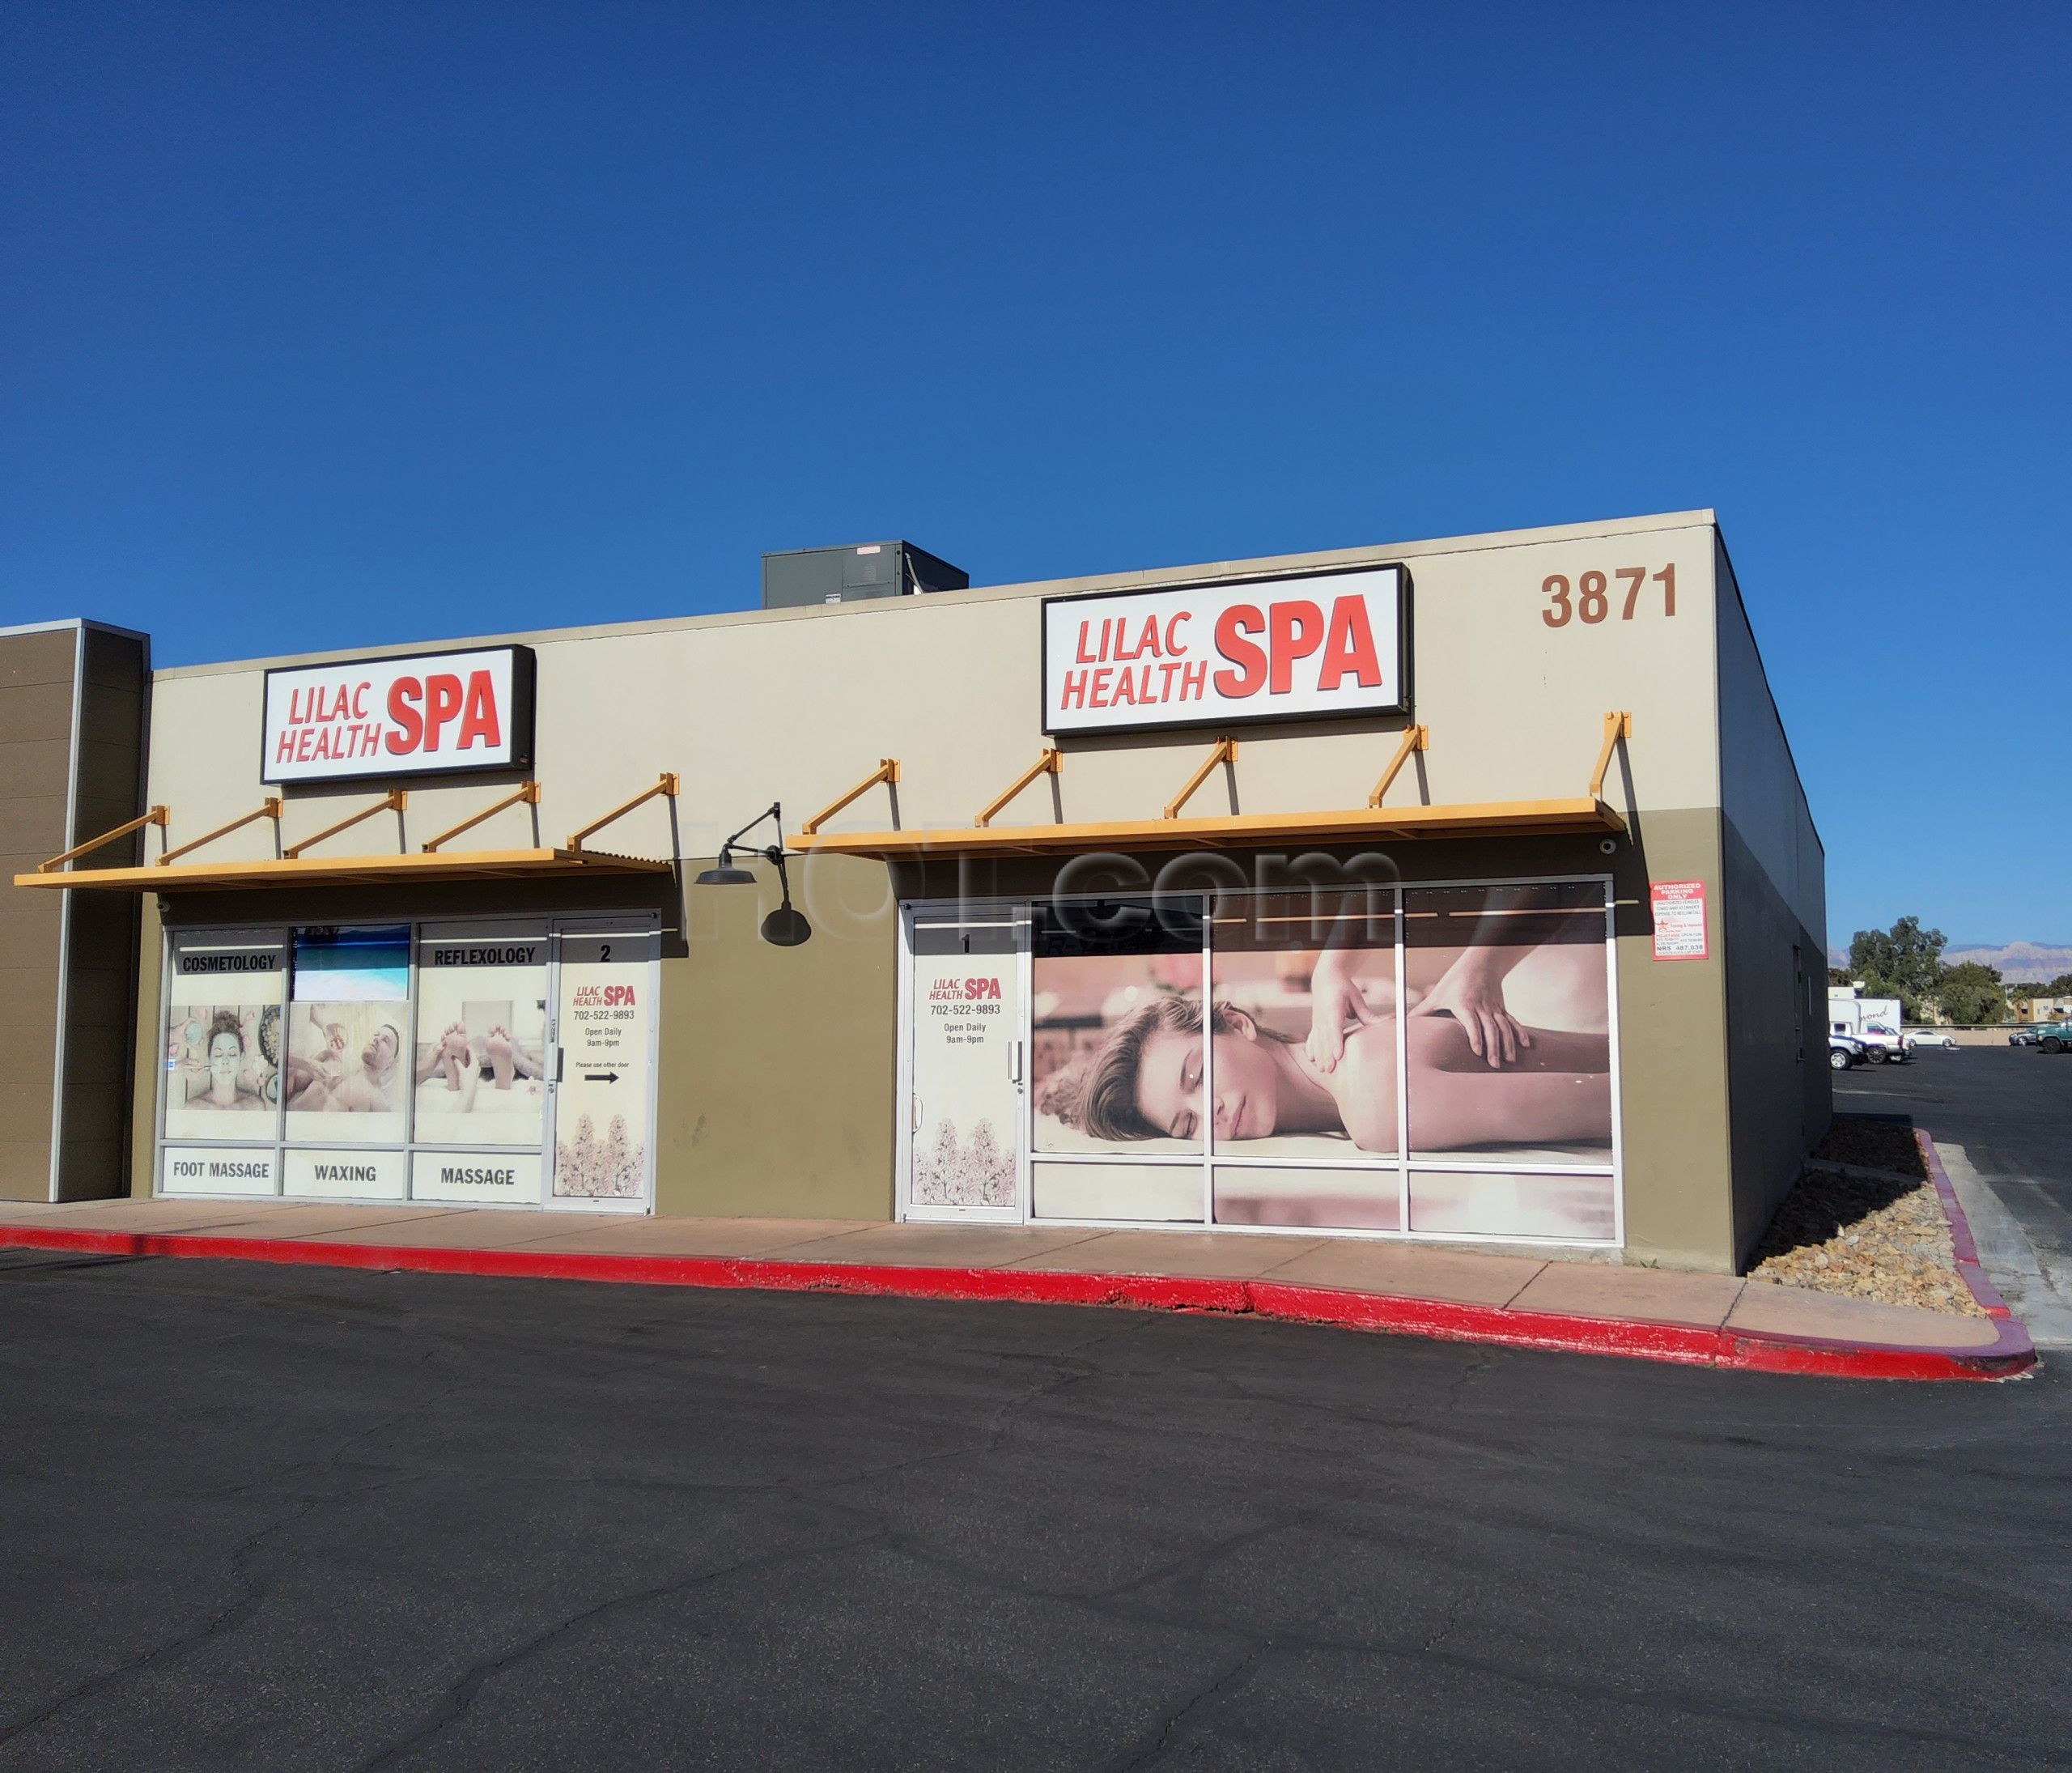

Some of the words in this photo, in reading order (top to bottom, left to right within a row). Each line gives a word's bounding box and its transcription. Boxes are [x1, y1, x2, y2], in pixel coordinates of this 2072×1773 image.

[1542, 563, 1675, 628] 3871
[1076, 611, 1192, 664] LILAC
[1213, 594, 1382, 699] SPA
[1060, 660, 1208, 710] HEALTH
[289, 682, 371, 725] LILAC
[385, 670, 501, 755] SPA
[276, 723, 381, 763] HEALTH
[962, 934, 970, 953] 1
[435, 947, 535, 966] REFLEXOLOGY
[600, 945, 611, 962] 2
[183, 955, 276, 972] COSMETOLOGY
[576, 986, 601, 996] LILAC
[933, 979, 960, 989] LILAC
[965, 978, 1002, 1000] SPA
[573, 997, 602, 1006] HEALTH
[604, 985, 635, 1006] SPA
[929, 989, 963, 1000] HEALTH
[574, 1010, 635, 1020] 702-522-9893
[931, 1004, 1000, 1015] 702-522-9893
[584, 1028, 602, 1036] Open
[605, 1027, 622, 1036] Daily
[944, 1023, 963, 1031] Open
[966, 1023, 986, 1032] Daily
[946, 1035, 984, 1044] 9am-9pm
[173, 1162, 205, 1177] FOOT
[209, 1163, 270, 1178] MASSAGE
[314, 1164, 376, 1182] WAXING
[440, 1167, 515, 1185] MASSAGE
